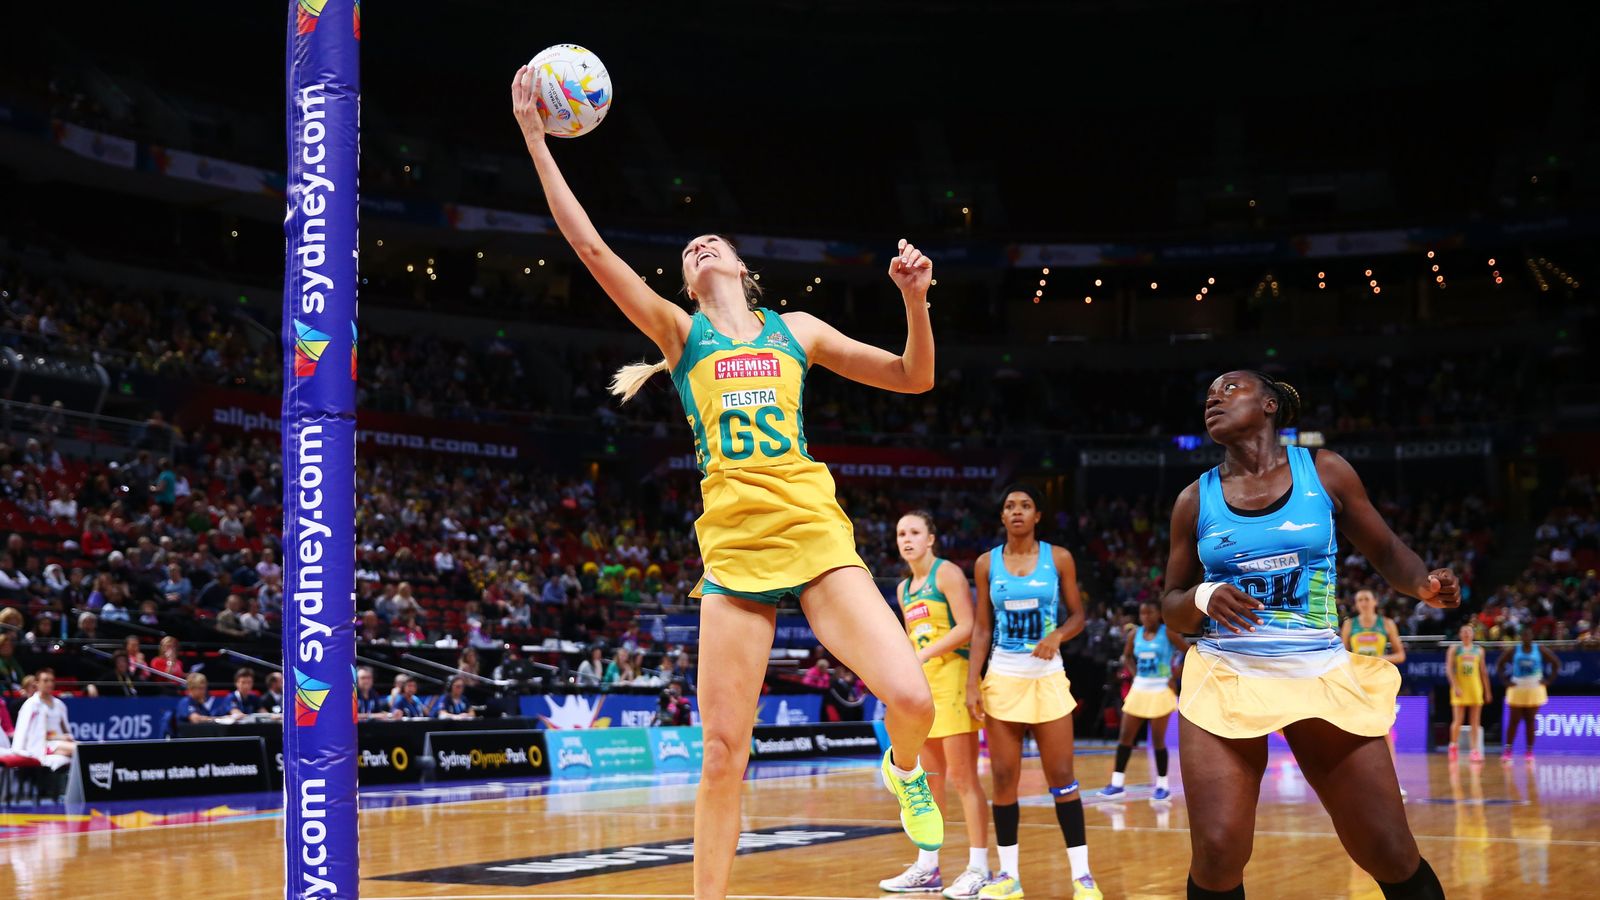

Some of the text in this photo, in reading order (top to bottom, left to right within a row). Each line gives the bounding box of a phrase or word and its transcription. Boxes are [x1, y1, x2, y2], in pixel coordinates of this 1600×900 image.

[297, 83, 334, 314] sydney.com
[717, 359, 779, 373] CHEMIST
[718, 371, 778, 379] WAREHOUSE
[722, 390, 776, 407] TELSTRA
[719, 406, 792, 460] GS
[294, 425, 332, 663] sydney.com
[1007, 610, 1043, 640] WD
[108, 715, 152, 740] 2015
[116, 762, 258, 782] The new state of business
